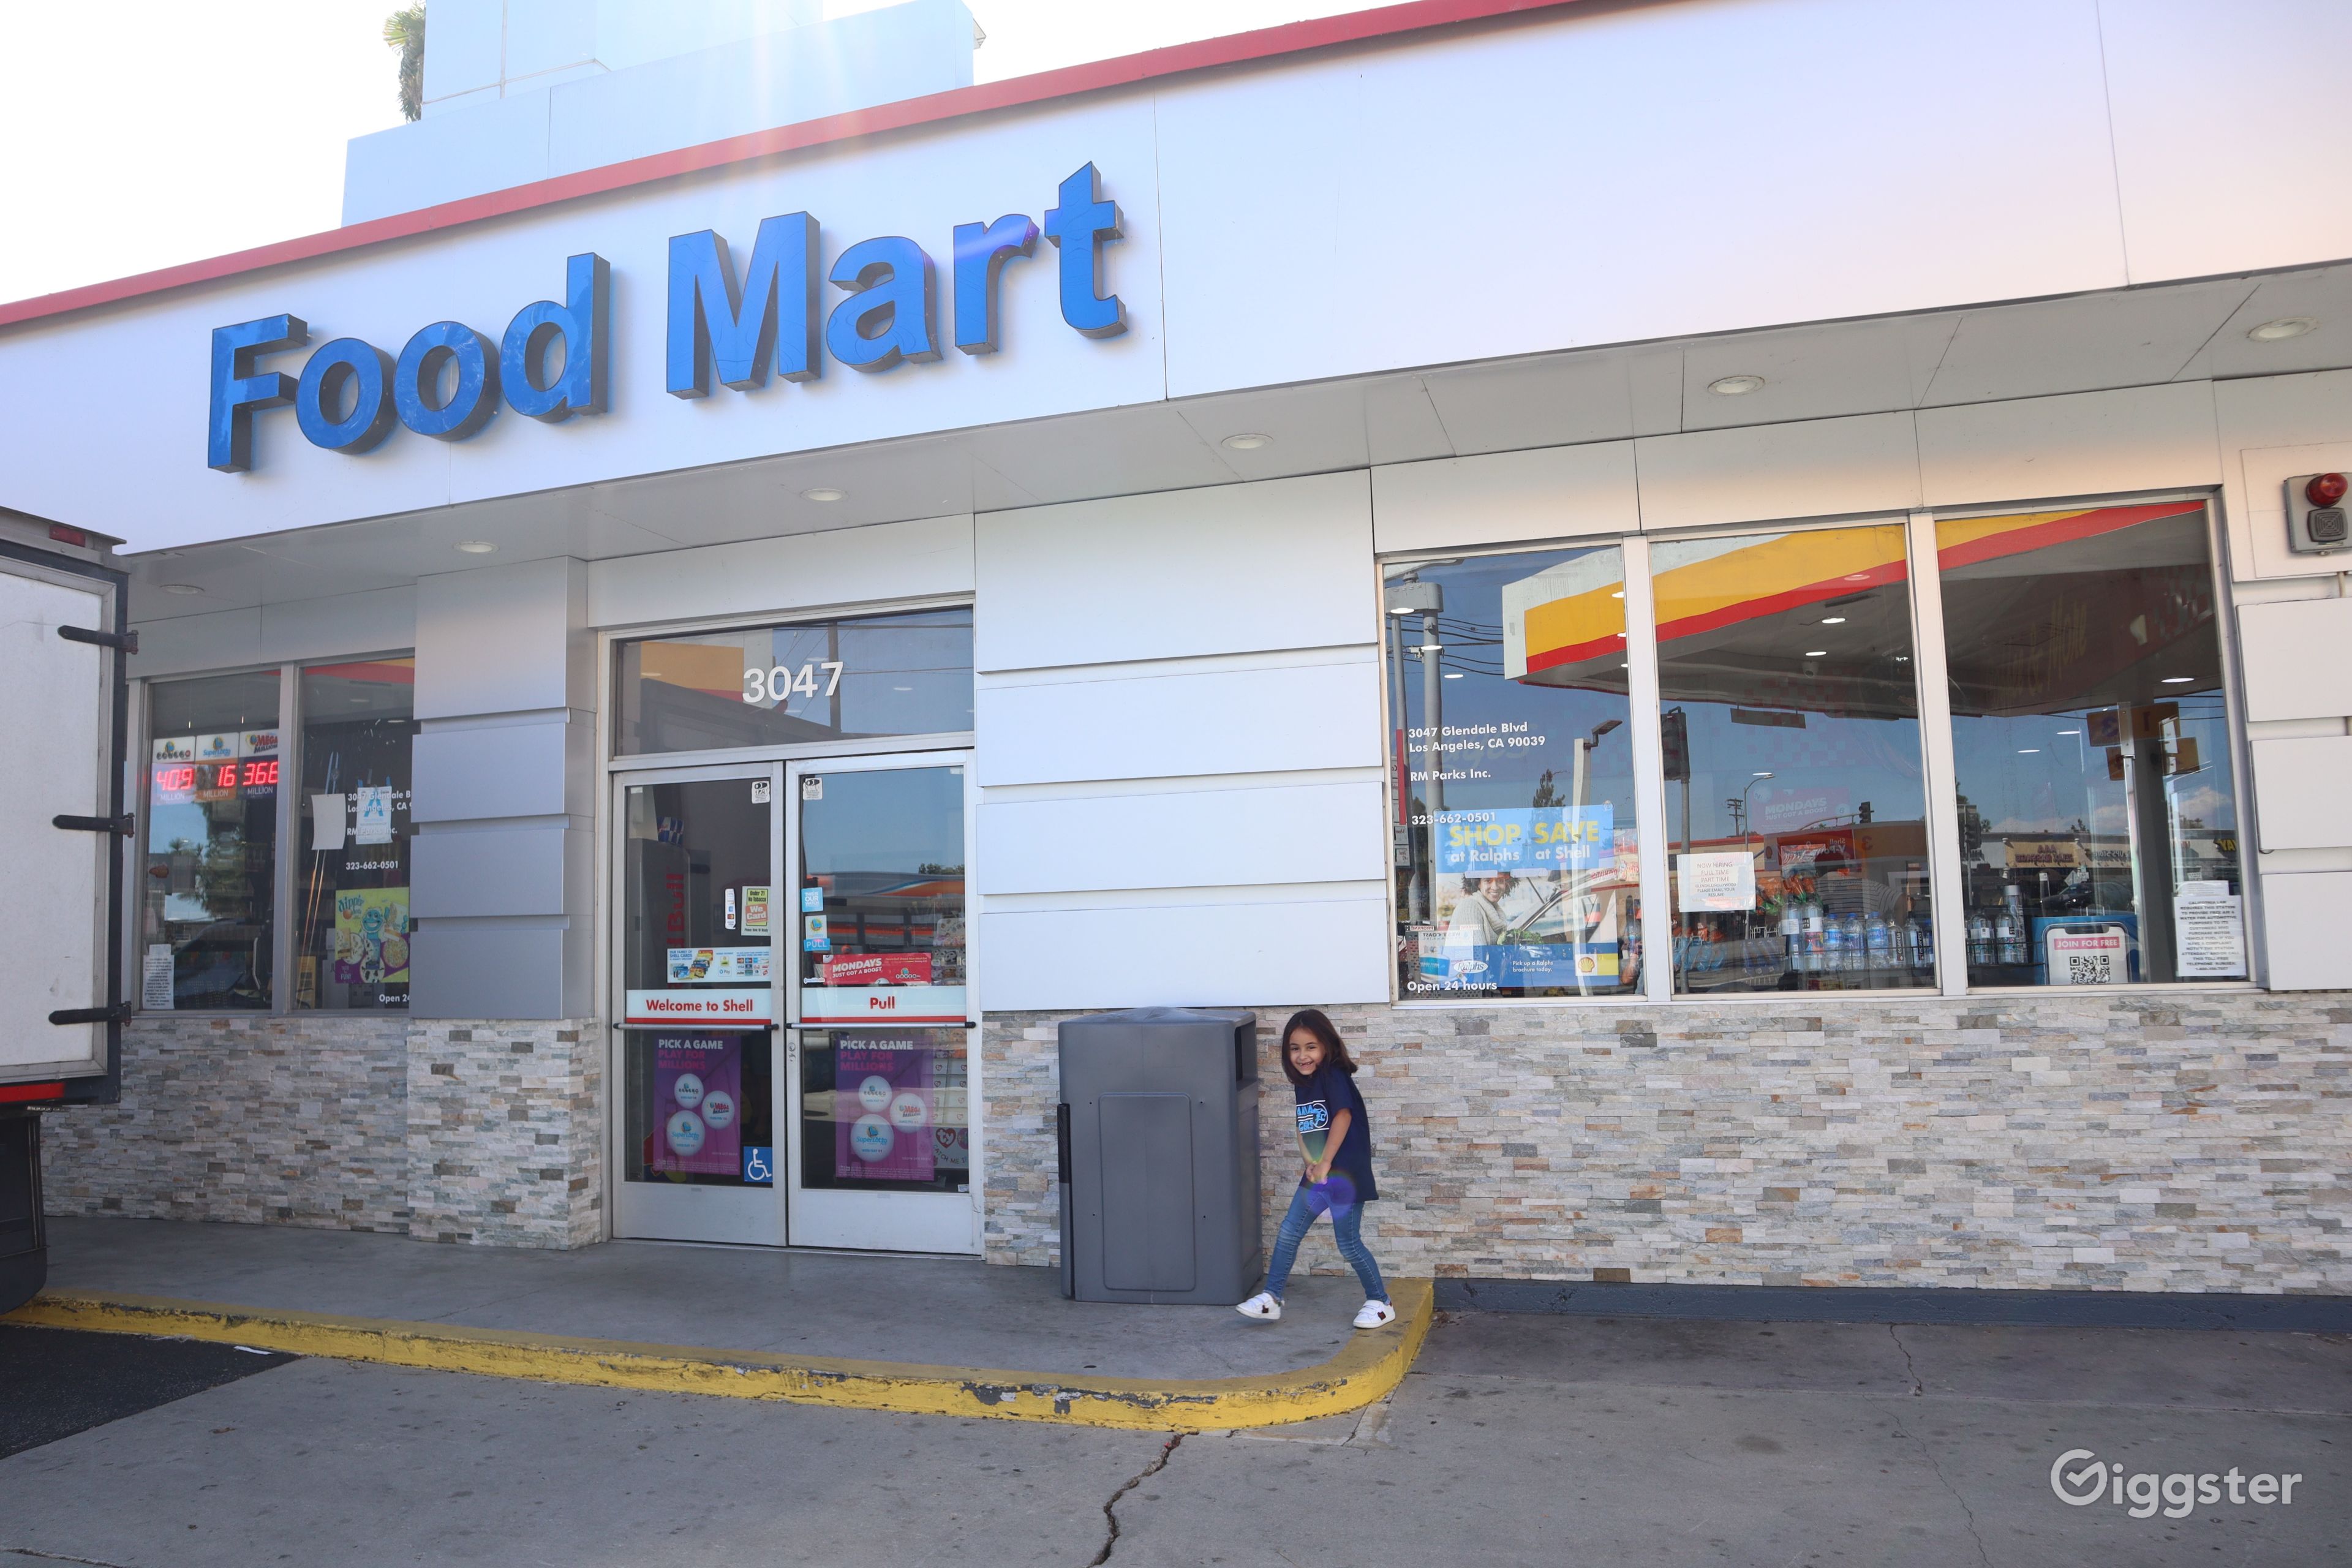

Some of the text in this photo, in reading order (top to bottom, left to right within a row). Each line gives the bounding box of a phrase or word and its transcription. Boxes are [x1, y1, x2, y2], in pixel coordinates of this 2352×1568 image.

[207, 160, 1127, 473] Food Mart
[742, 661, 843, 704] 3047
[1409, 722, 1528, 738] 3047 Glendale Blvd
[1409, 736, 1545, 753] Los Angeles, CA 90039
[156, 767, 194, 791] 409
[218, 764, 237, 787] 16
[1411, 769, 1491, 782] RM Parks Inc.
[203, 790, 228, 799] MILLION
[247, 786, 273, 795] MILLION
[1765, 797, 1827, 815] MONDAYS
[1411, 812, 1496, 825] 323-662-0501
[1450, 821, 1599, 847] SHOP SAVE
[1450, 845, 1590, 865] at Ralphs at Shell
[345, 861, 398, 870] 323-662-0501
[747, 911, 767, 920] Card
[807, 940, 827, 949] PULL
[832, 958, 882, 973] MONDAYS
[1458, 961, 1485, 973] Ralphs
[1407, 981, 1497, 993] Open 24 hours
[379, 993, 400, 1004] Open
[870, 997, 895, 1009] Pull
[646, 999, 753, 1012] Welcome to Shell
[658, 1039, 723, 1049] PICK A GAME
[840, 1040, 913, 1050] PICK A GAME
[658, 1050, 706, 1059] PLAY FOR
[840, 1051, 892, 1060] PLAY FOR
[658, 1060, 706, 1070] MILLIONS
[840, 1061, 893, 1071] MILLIONS
